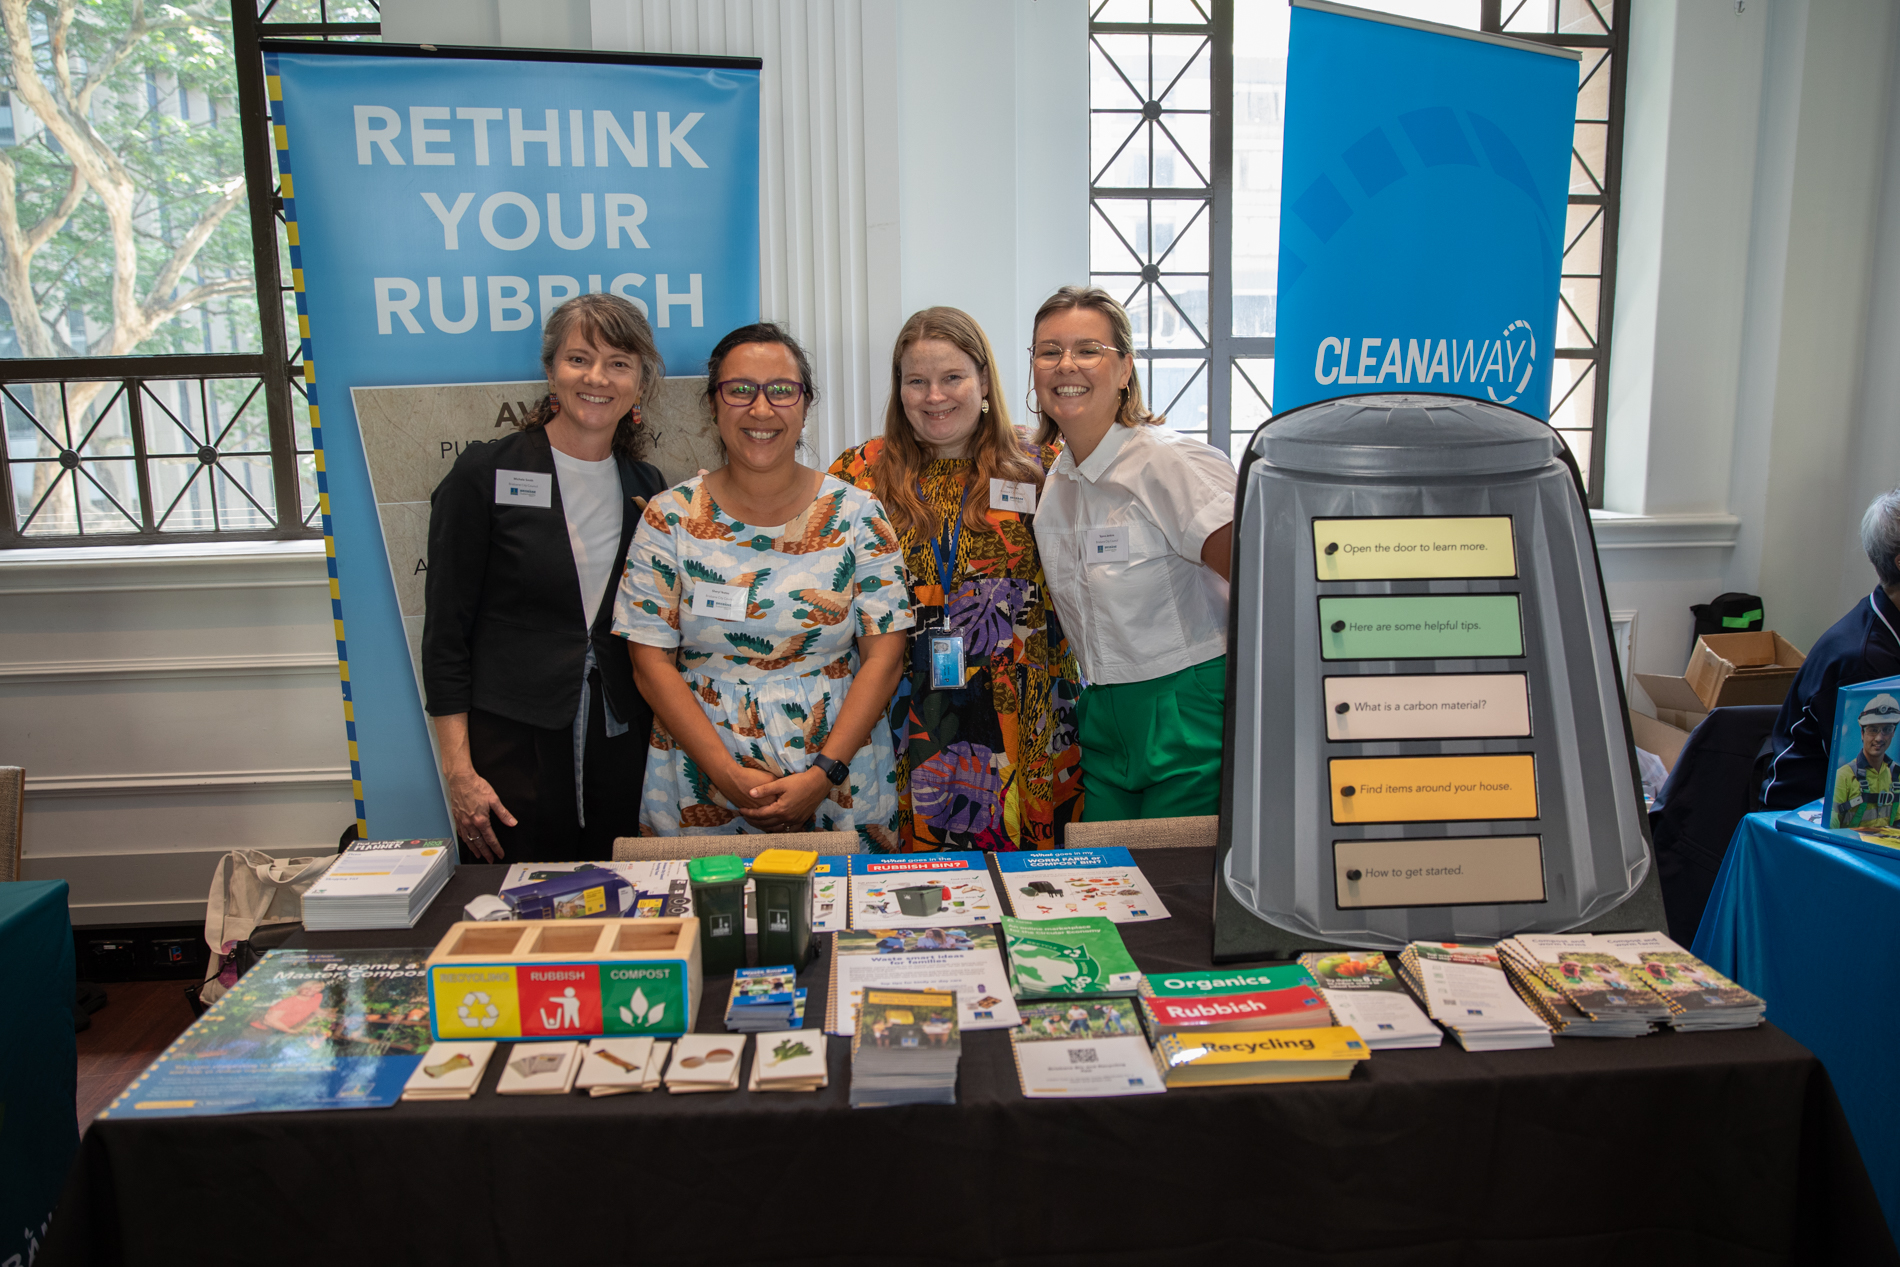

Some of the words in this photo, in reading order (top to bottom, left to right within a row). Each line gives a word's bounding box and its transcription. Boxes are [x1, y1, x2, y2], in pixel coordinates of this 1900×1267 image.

[353, 104, 710, 169] RETHINK
[420, 191, 651, 251] YOUR
[1314, 336, 1527, 386] CLEANAWAY
[1343, 543, 1372, 556] Open
[1375, 543, 1391, 552] the
[1393, 542, 1417, 552] door
[1420, 543, 1430, 552] to
[1433, 542, 1457, 552] learn
[1460, 543, 1488, 551] more.
[1349, 622, 1373, 632] Here
[1394, 623, 1421, 631] some
[1424, 620, 1458, 633] helpful
[1461, 621, 1482, 633] tips.
[1354, 702, 1381, 712] What
[1384, 701, 1392, 711] is
[1394, 703, 1401, 711] a
[1403, 701, 1438, 711] carbon
[1441, 700, 1487, 710] material?
[1360, 783, 1383, 794] Find
[1385, 783, 1413, 794] items
[1415, 782, 1451, 793] around
[1454, 783, 1477, 795] your
[1479, 781, 1513, 791] house.
[353, 843, 402, 851] PLANNER
[873, 863, 928, 871] RUBBISH
[1365, 868, 1389, 878] How
[1392, 868, 1403, 878] to
[1405, 867, 1423, 880] get
[1425, 865, 1464, 876] started.
[323, 963, 400, 972] Become
[273, 970, 344, 980] Master
[346, 969, 427, 980] Compos
[439, 972, 510, 983] RECYCLING
[530, 971, 586, 982] RUBBISH
[610, 969, 671, 980] COMPOST
[1163, 975, 1272, 991] Organics
[1166, 1000, 1267, 1018] Rubbish
[1201, 1038, 1316, 1054] Recycling
